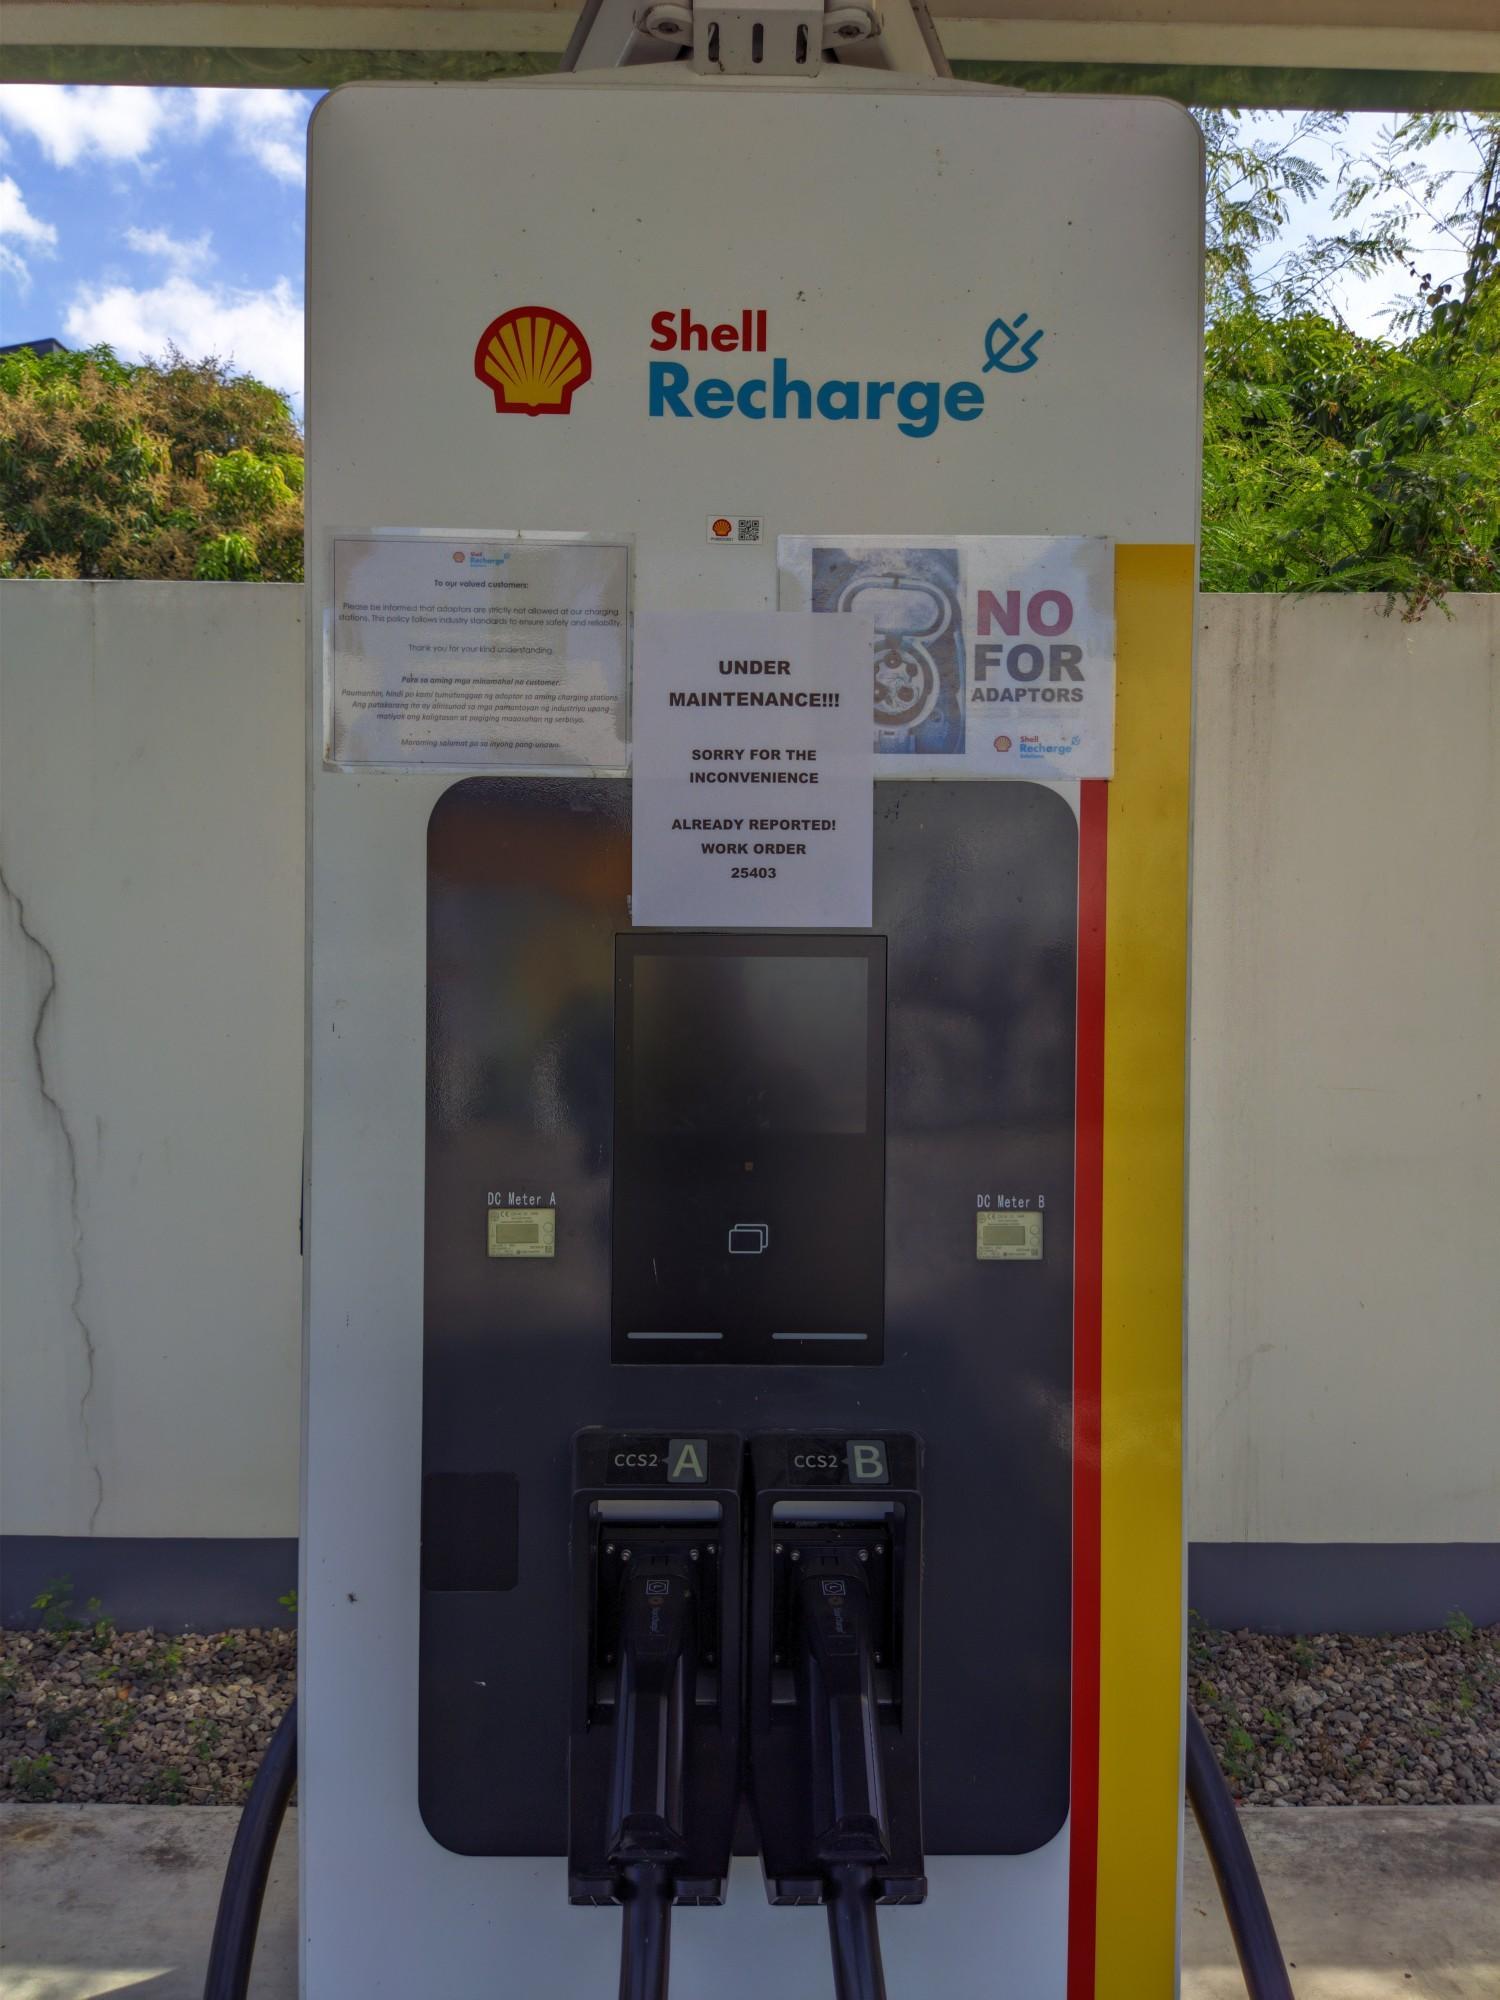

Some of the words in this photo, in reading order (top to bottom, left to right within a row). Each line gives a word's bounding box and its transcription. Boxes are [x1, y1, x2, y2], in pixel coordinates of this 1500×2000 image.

[649, 309, 767, 352] Shell
[649, 358, 984, 438] Recharge
[445, 580, 457, 588] our
[488, 581, 529, 589] customers:
[343, 602, 368, 611] Please
[370, 603, 379, 611] be
[383, 603, 417, 612] informed
[420, 605, 434, 613] that
[437, 605, 471, 614] adaptors
[489, 607, 511, 615] strictly
[514, 607, 526, 615] not
[528, 607, 559, 616] allowed
[561, 608, 569, 616] at
[585, 608, 619, 617] charging
[977, 590, 1073, 637] NO
[387, 615, 409, 624] policy
[412, 615, 437, 623] follows
[440, 616, 467, 625] industry
[470, 616, 507, 625] standards
[546, 618, 568, 627] safety
[408, 644, 430, 652] Thank
[449, 644, 459, 652] for
[461, 646, 478, 654] your
[719, 661, 791, 675] UNDER
[974, 644, 1085, 682] FOR
[430, 677, 452, 685] aming
[386, 689, 403, 697] hindi
[535, 694, 556, 702] aming
[558, 694, 588, 702] charging
[668, 692, 840, 708] MAINTENANCE!!!
[971, 687, 1083, 702] ADAPTORS
[352, 701, 366, 709] Ang
[692, 749, 744, 761] SORRY
[750, 749, 781, 761] FOR
[786, 749, 817, 761] THE
[1020, 743, 1072, 755] Recharge
[690, 772, 819, 784] INCONVENIENCE
[671, 819, 744, 831] ALREADY
[749, 819, 836, 831] REPORTED!
[701, 843, 748, 855] WORK
[753, 843, 806, 855] ORDER
[731, 867, 777, 879] 25403
[487, 1191, 501, 1206] DC
[509, 1191, 541, 1206] Meter
[549, 1191, 556, 1206] A
[977, 1194, 990, 1208] DC
[998, 1194, 1031, 1208] Meter
[1039, 1194, 1045, 1208] B
[614, 1454, 658, 1467] CCS2
[672, 1444, 703, 1478] A
[794, 1455, 838, 1468] CCS2
[854, 1445, 883, 1478] B
